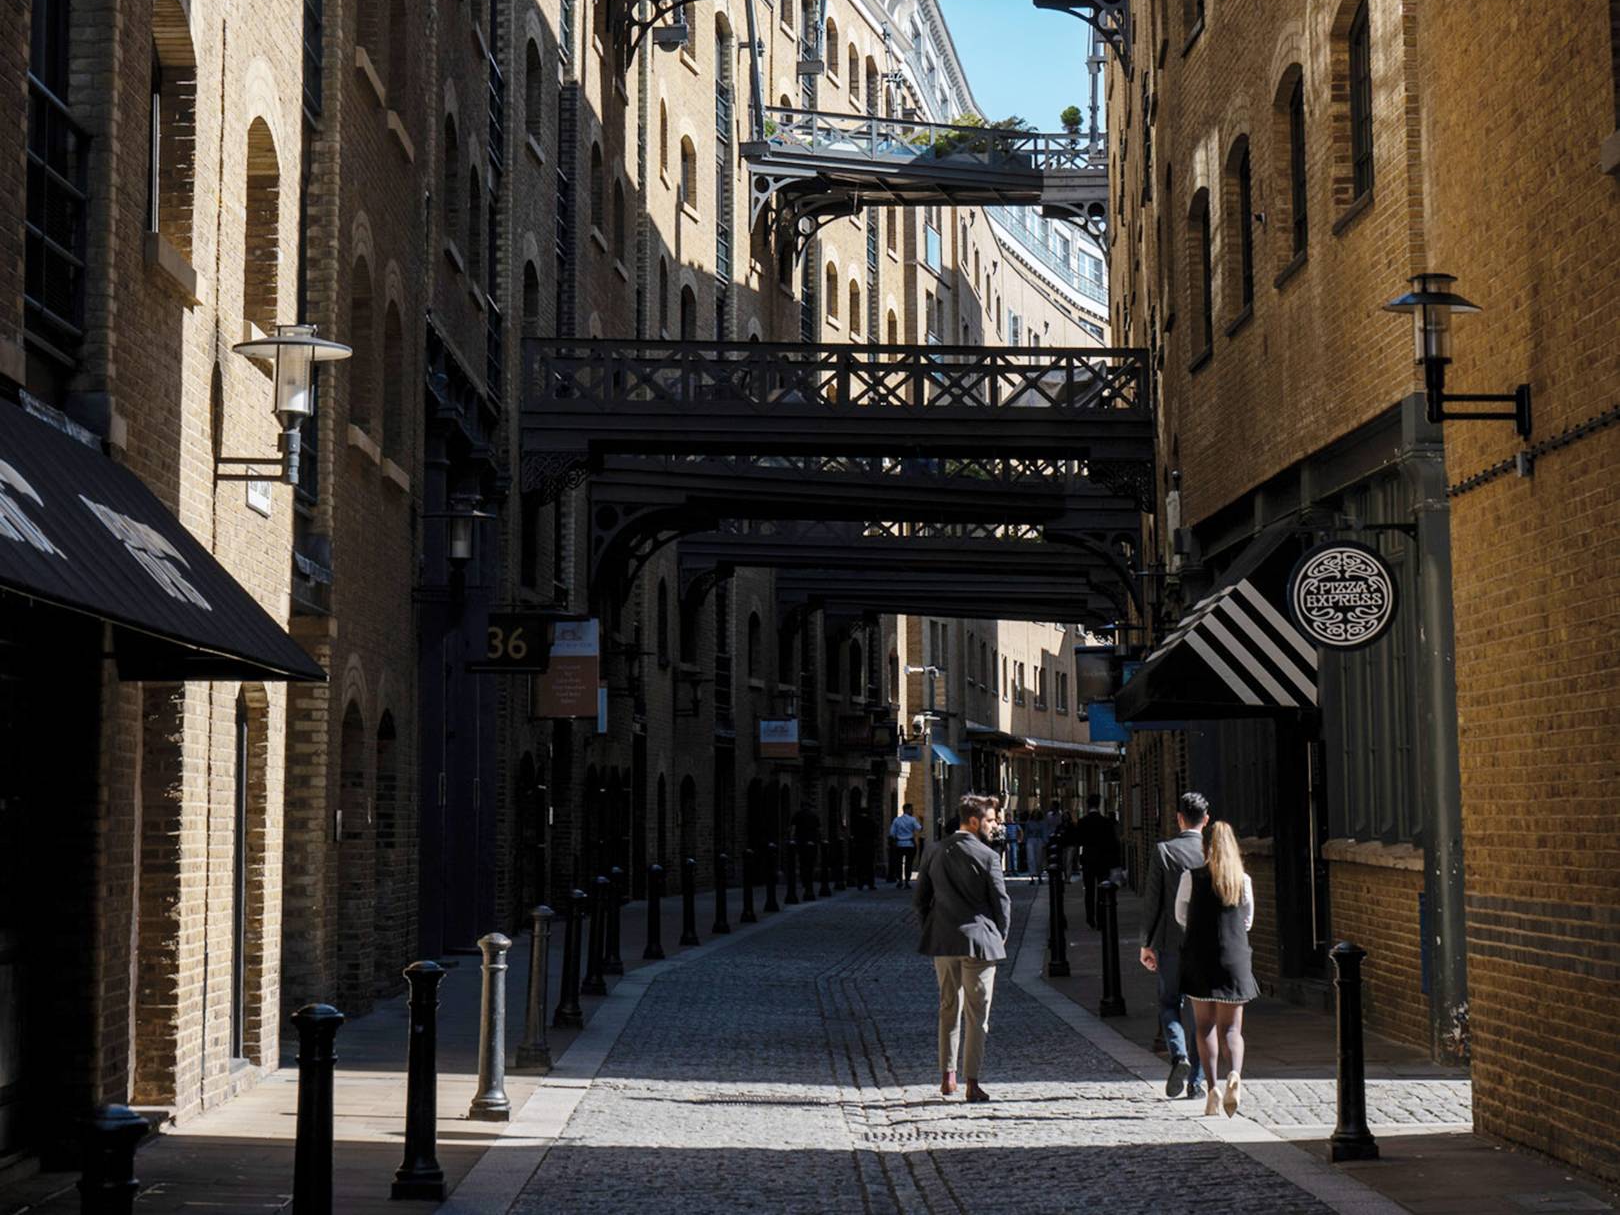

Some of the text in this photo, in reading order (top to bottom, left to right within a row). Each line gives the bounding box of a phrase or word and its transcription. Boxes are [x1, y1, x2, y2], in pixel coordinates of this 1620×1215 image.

[1319, 581, 1368, 594] PIZZA
[1306, 593, 1382, 607] EXPRESS
[487, 626, 528, 660] 36
